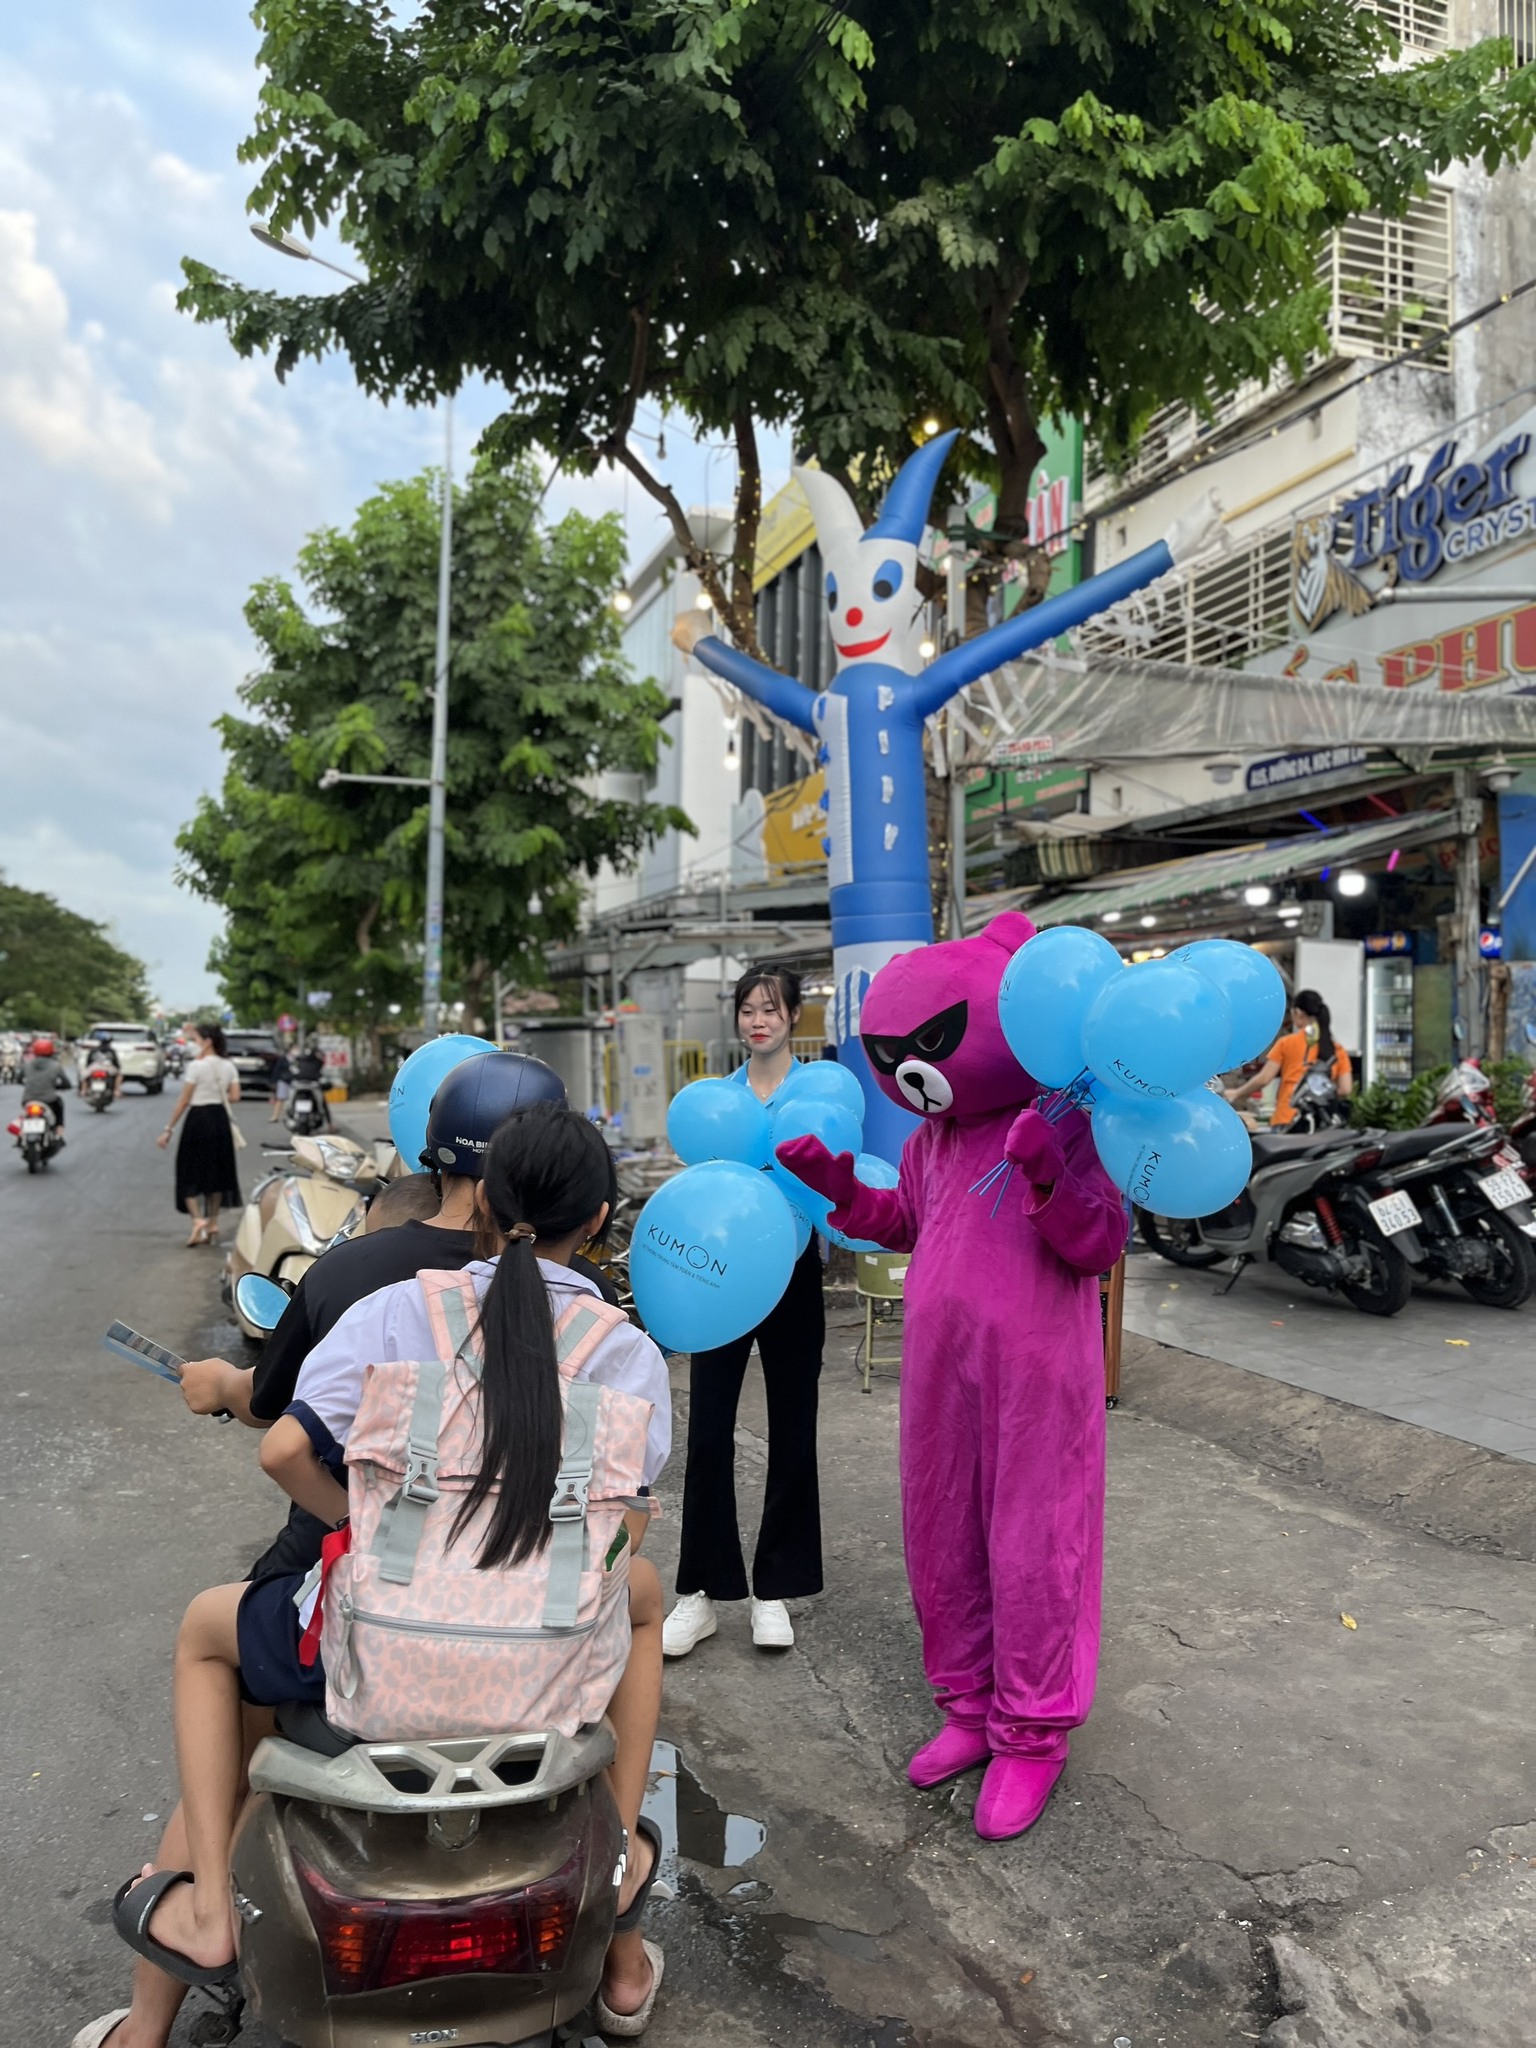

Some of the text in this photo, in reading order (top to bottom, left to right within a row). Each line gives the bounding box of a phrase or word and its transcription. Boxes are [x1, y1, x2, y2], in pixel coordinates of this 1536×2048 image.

[1328, 432, 1531, 582] Tiger
[1113, 1059, 1180, 1098] KUMON
[647, 1223, 728, 1277] KUMON
